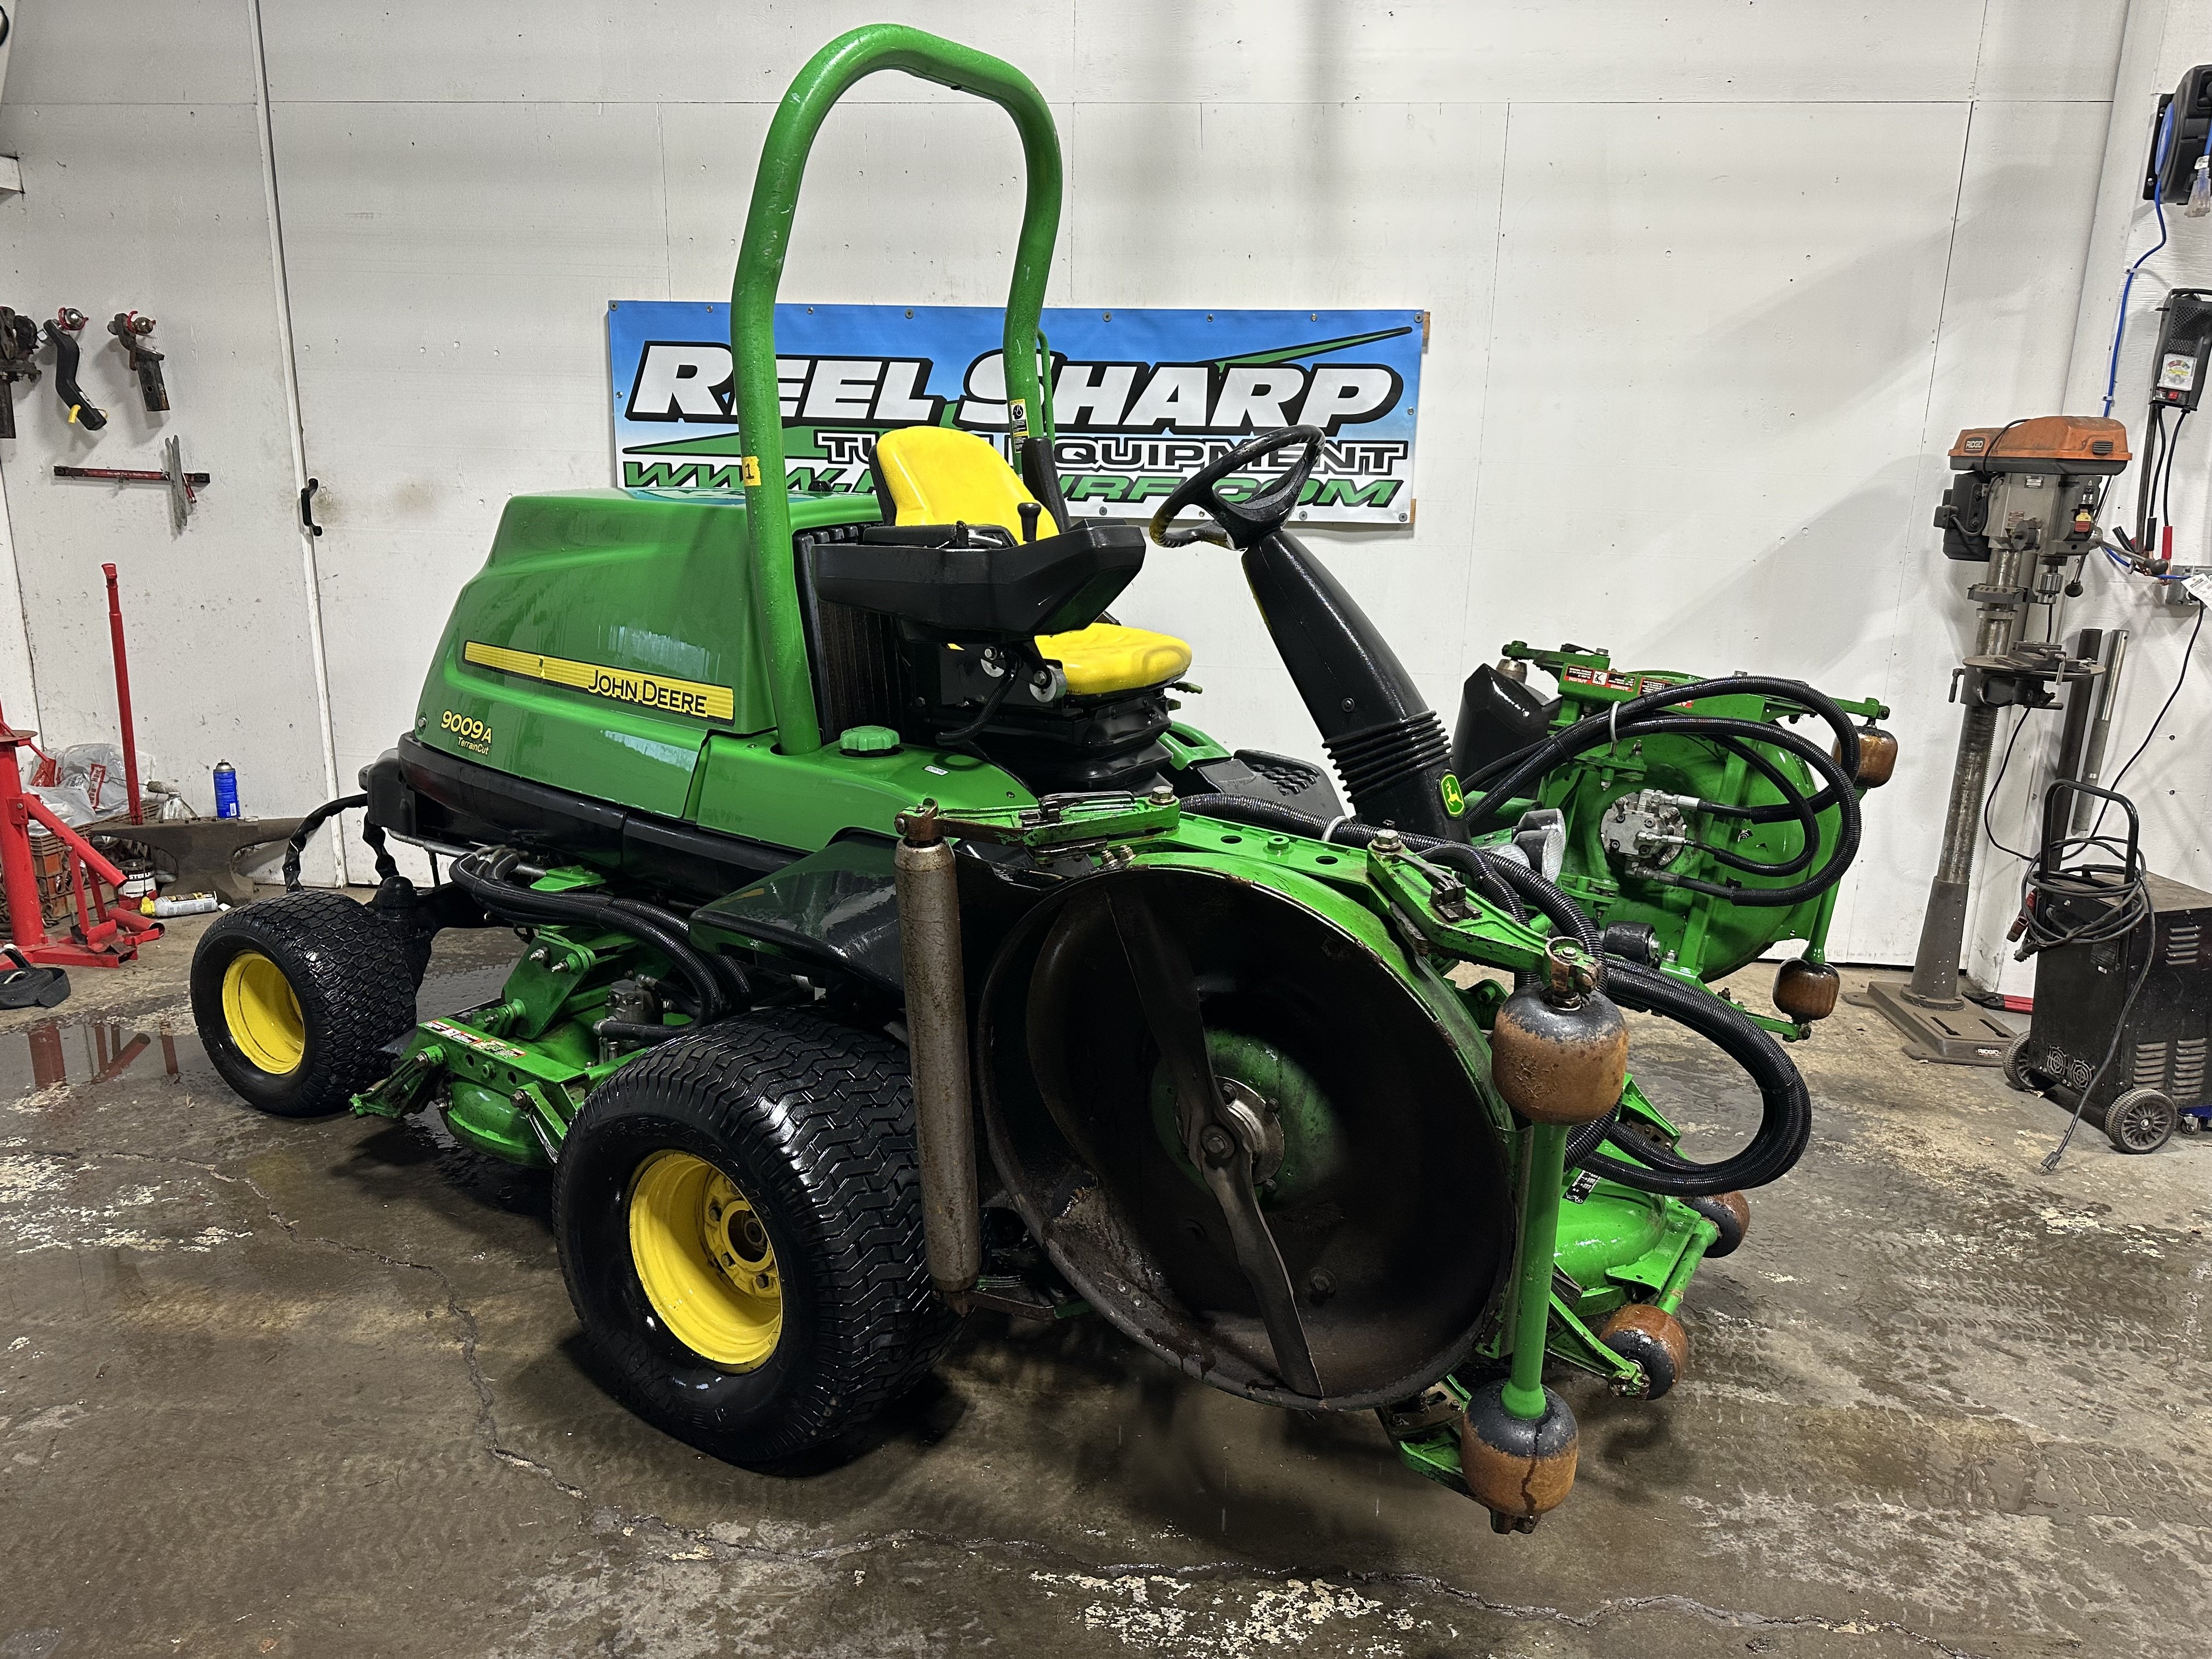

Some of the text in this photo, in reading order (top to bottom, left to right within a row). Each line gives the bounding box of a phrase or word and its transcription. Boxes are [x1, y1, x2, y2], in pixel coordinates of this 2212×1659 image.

[1005, 436, 1408, 475] QUIPENT
[1965, 440, 1983, 448] RIDGID
[588, 669, 707, 715] JOHN DEERE
[441, 710, 492, 744] 9009A
[458, 736, 489, 755] TerrainCut
